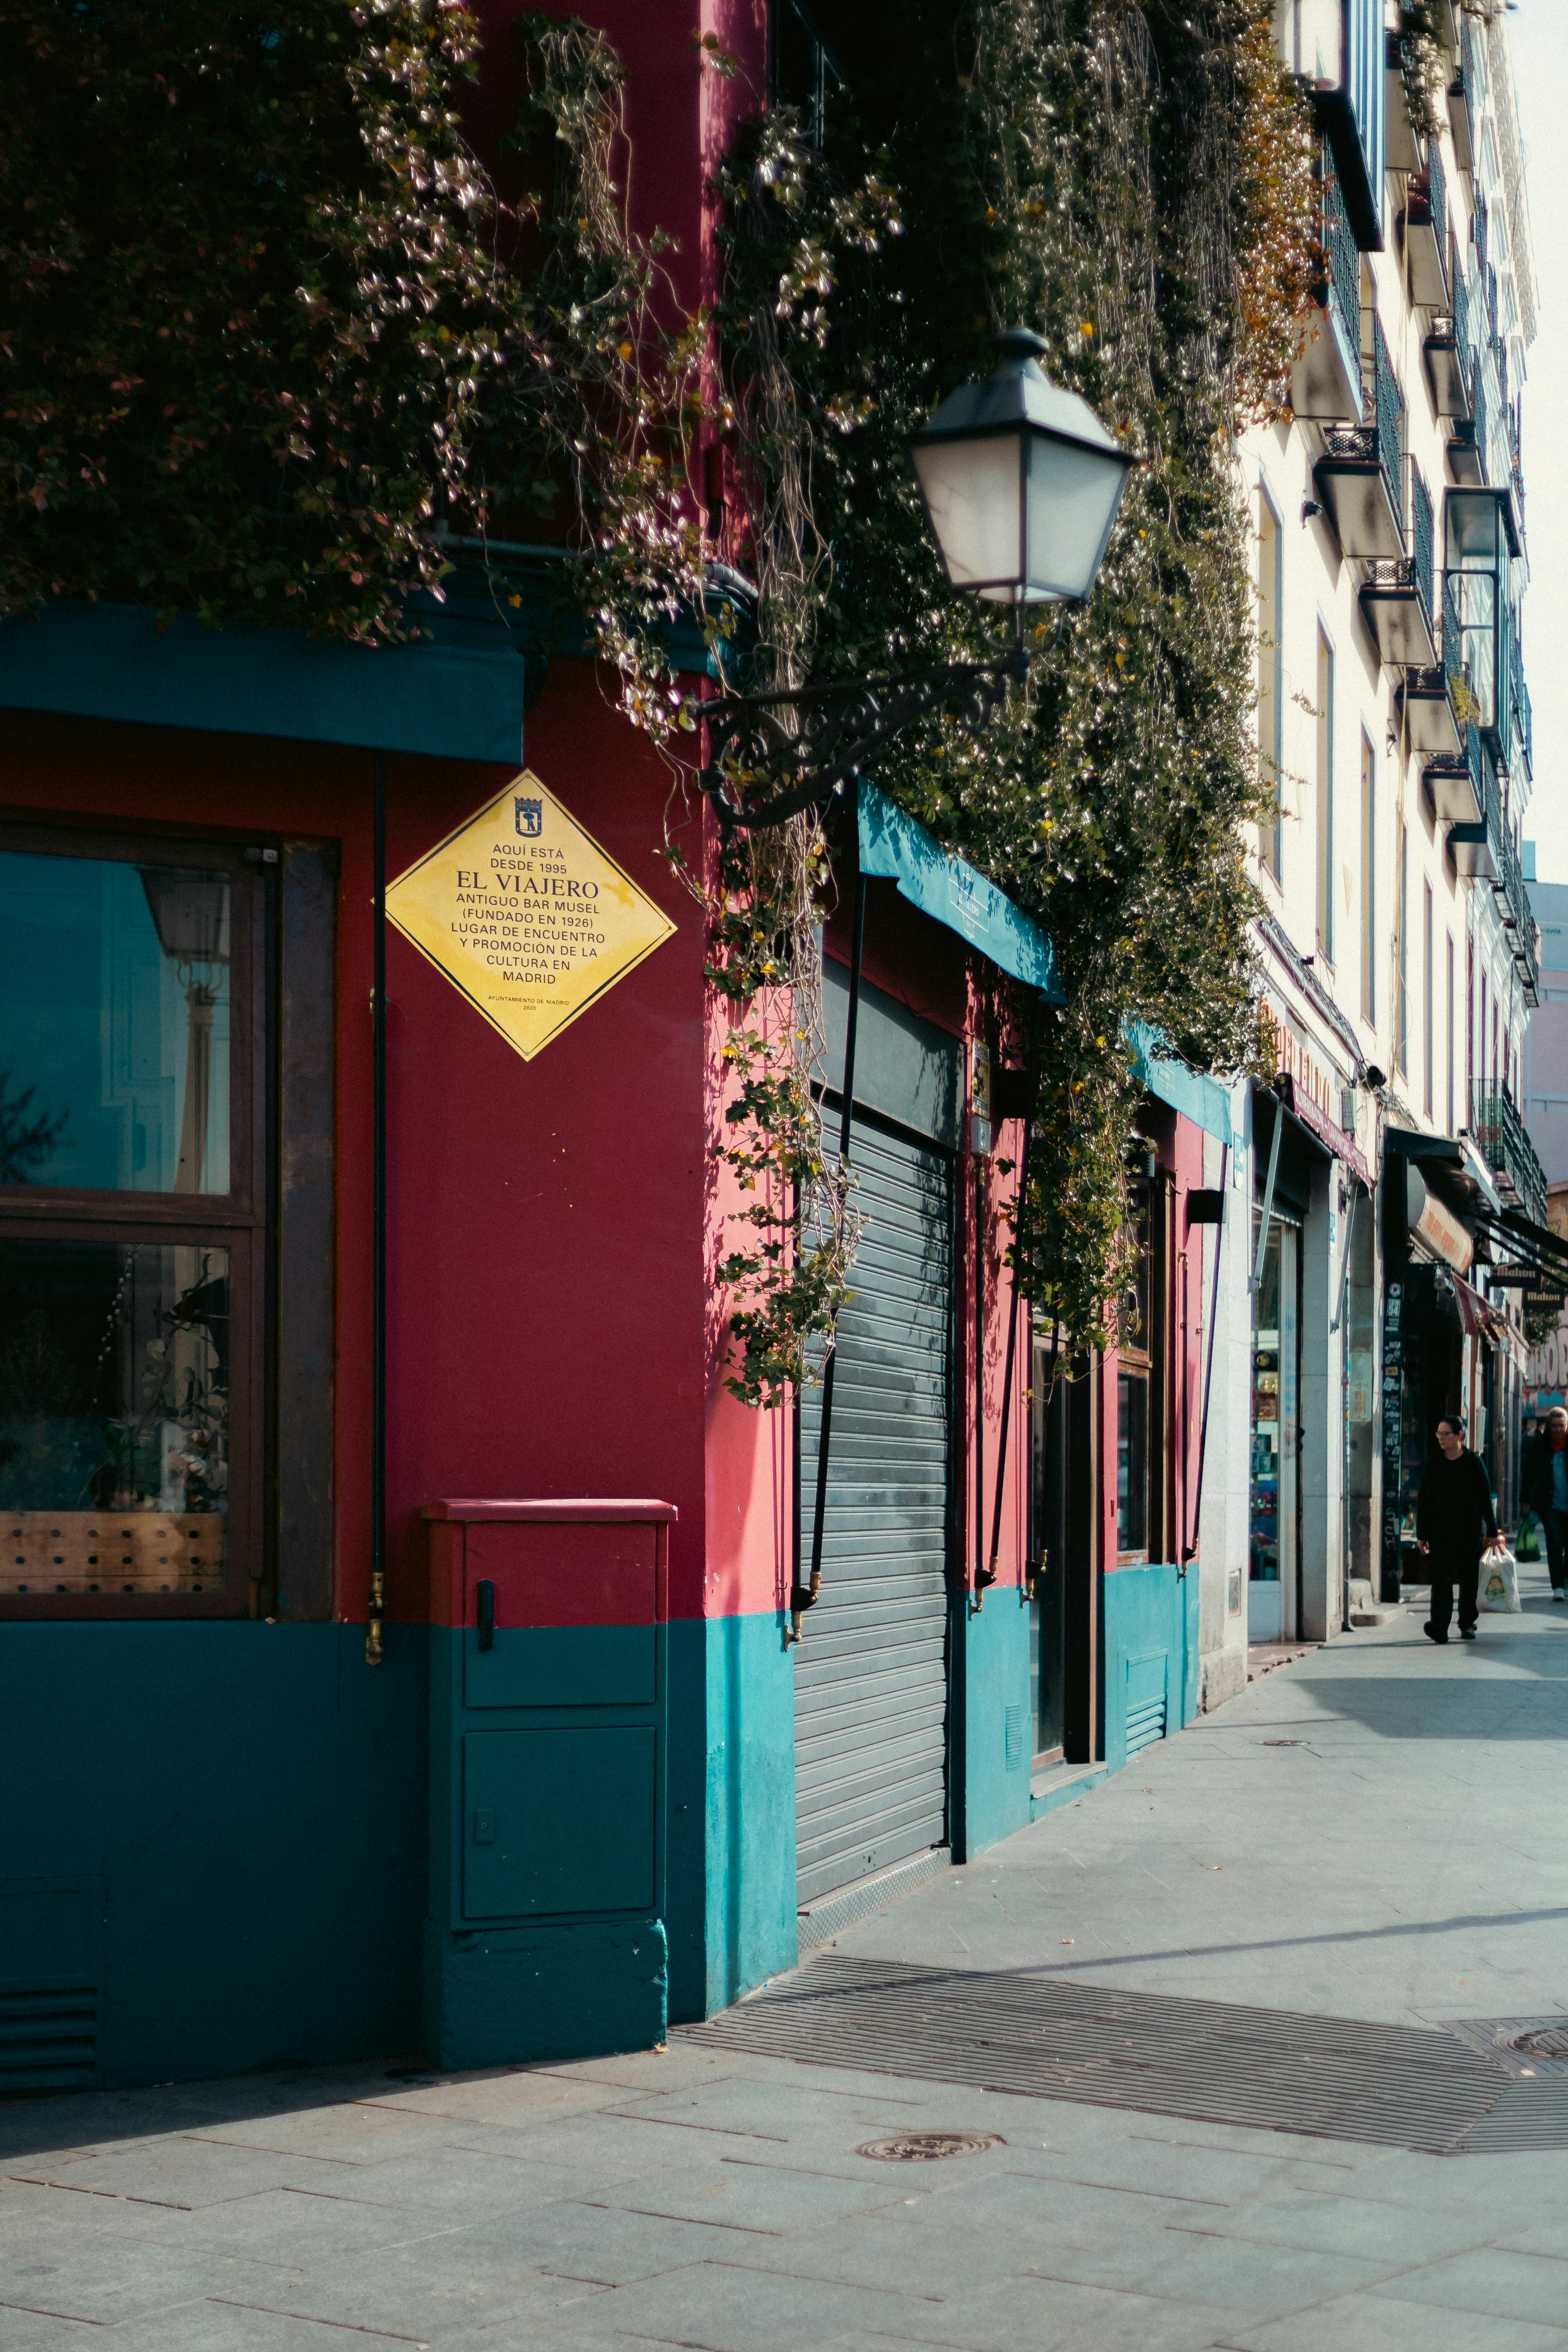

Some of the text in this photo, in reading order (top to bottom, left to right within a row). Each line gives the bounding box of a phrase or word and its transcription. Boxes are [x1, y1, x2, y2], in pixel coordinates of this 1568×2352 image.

[493, 844, 564, 859] AQUÍ ESTÁ
[491, 858, 566, 874] DESDE 1995
[456, 871, 599, 898] EL VIAJERO
[456, 893, 599, 914] ANTIGUO BAR MUSEL
[958, 894, 979, 917] EL VIAJERO
[463, 908, 593, 929] (FUNDADO EN 1926)
[452, 922, 605, 944] LUGAR DE ENCUENTRO
[459, 938, 597, 958] Y PROMOCIÓN DE LA
[487, 955, 570, 970] CULTURA EN
[503, 971, 555, 984] MADRID
[1497, 1267, 1536, 1278] Mahou
[1527, 1291, 1560, 1301] Mahou
